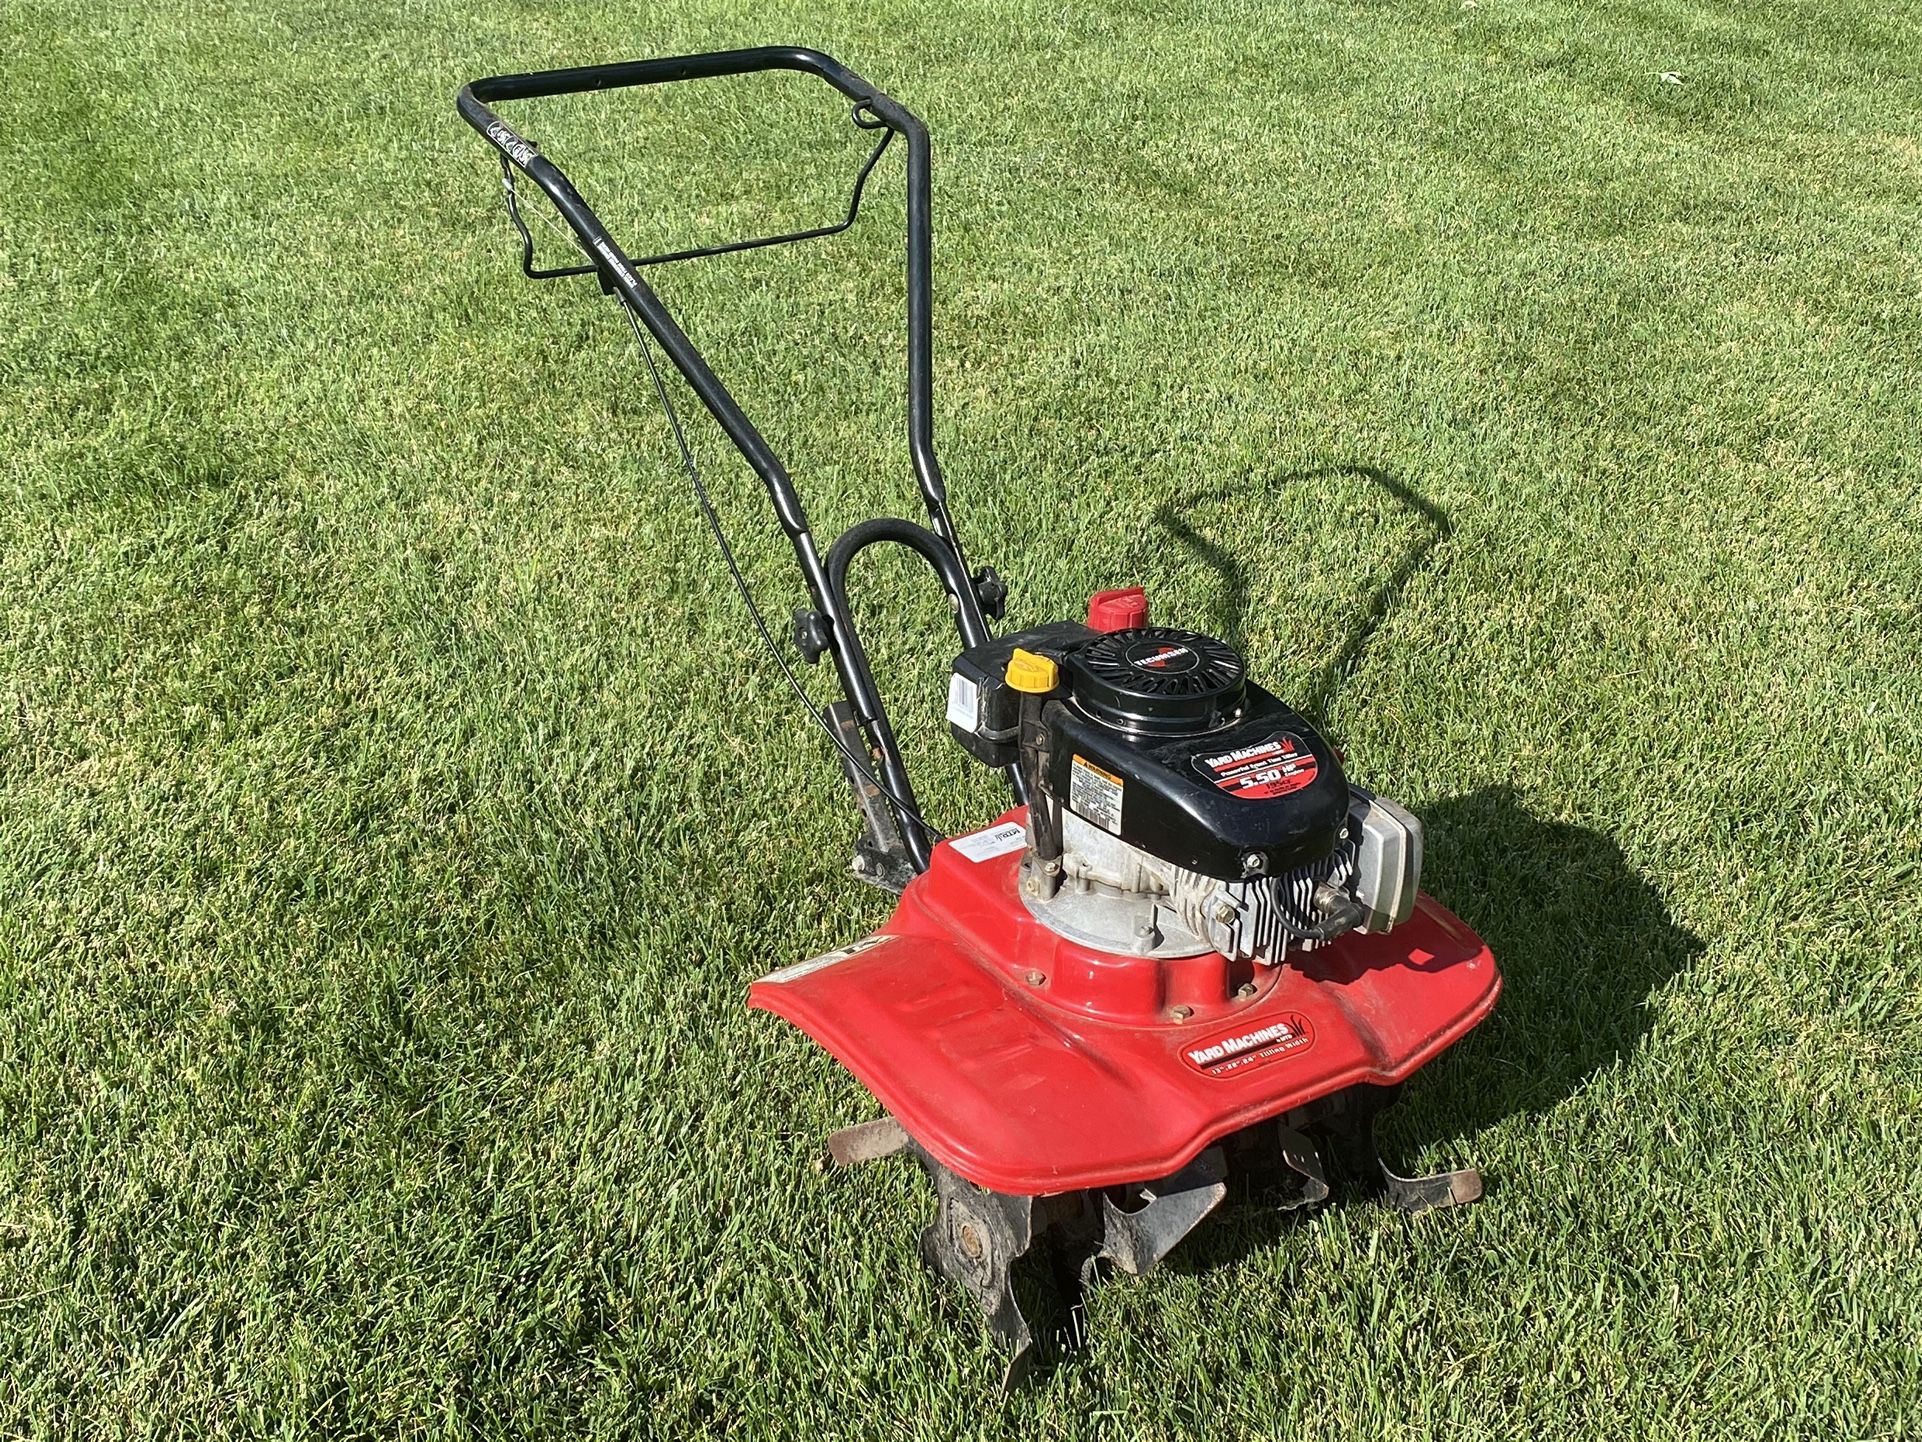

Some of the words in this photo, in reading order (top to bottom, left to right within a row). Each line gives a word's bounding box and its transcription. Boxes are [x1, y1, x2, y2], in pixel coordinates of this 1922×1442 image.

[1204, 754, 1233, 768] YARD
[1230, 741, 1282, 761] MACHINES
[1220, 765, 1250, 777] Powerful
[1239, 769, 1282, 789] 5.50
[1281, 763, 1297, 773] HP
[1187, 1044, 1225, 1064] YARD
[1221, 1022, 1289, 1053] MACHINES
[1259, 1046, 1286, 1058] Tilling
[1284, 1037, 1309, 1049] Width
